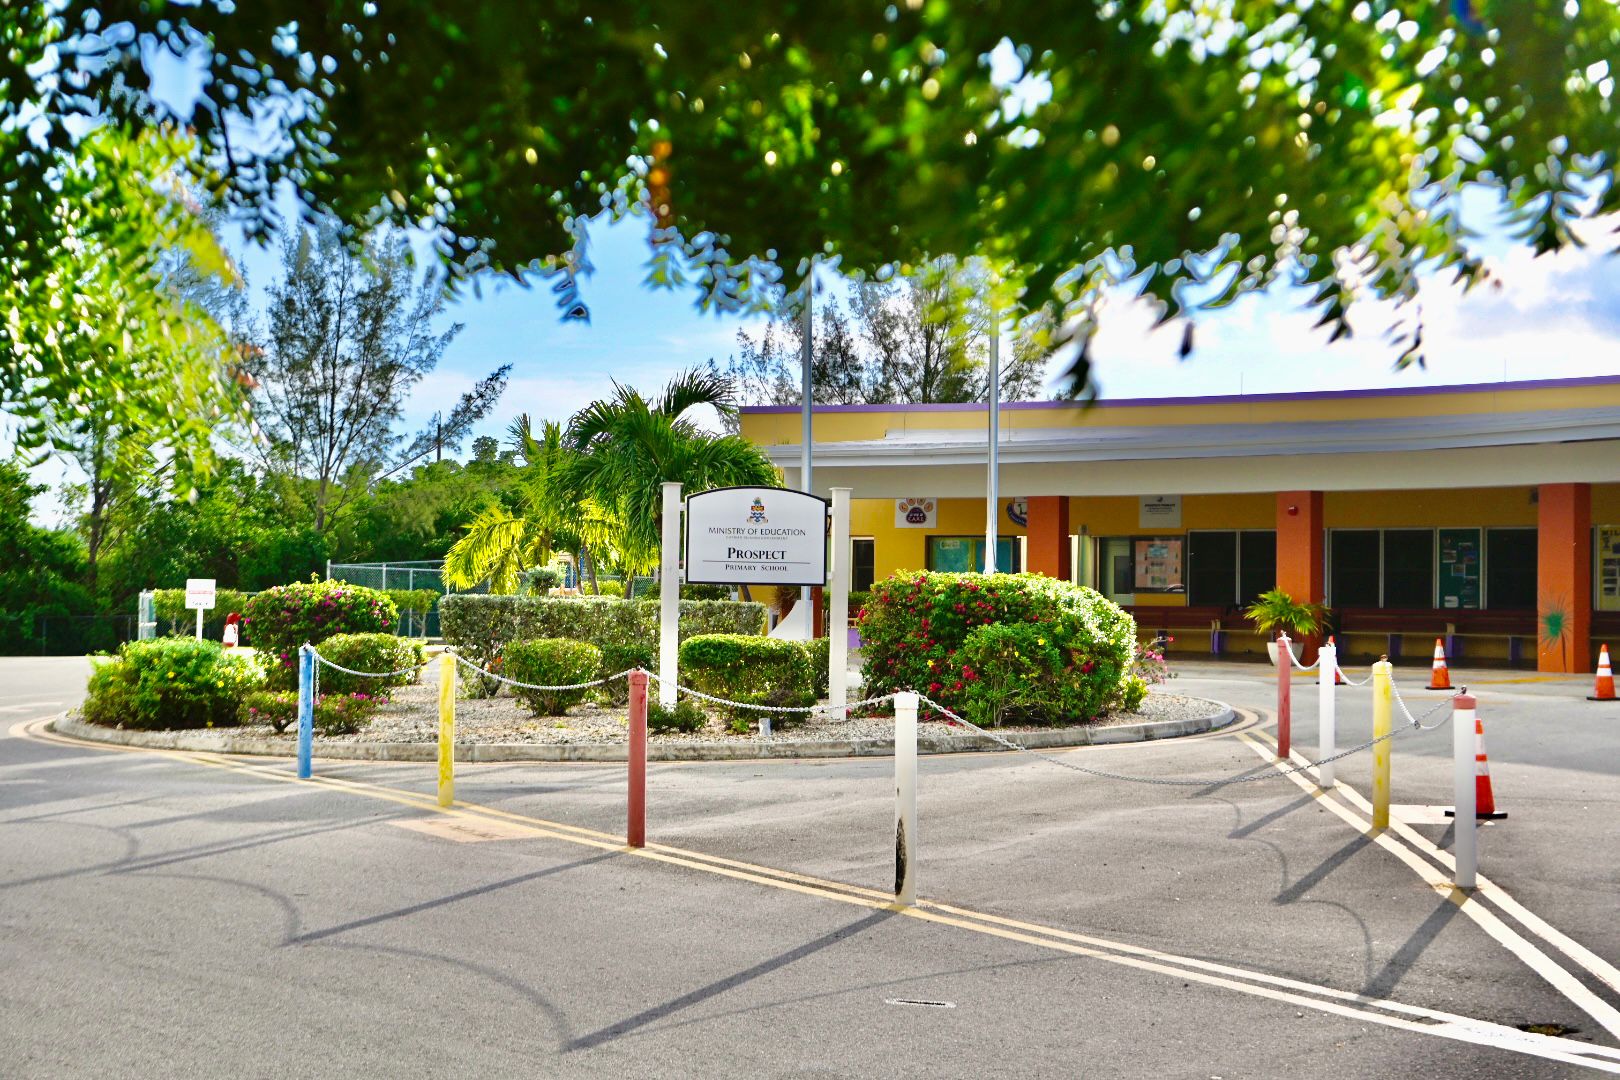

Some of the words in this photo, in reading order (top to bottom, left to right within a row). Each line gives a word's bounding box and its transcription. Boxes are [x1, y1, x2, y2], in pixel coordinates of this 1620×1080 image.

[708, 527, 746, 535] MINISTRY
[760, 528, 806, 536] EDUCATION
[727, 547, 787, 560] PROSPECT
[760, 564, 788, 572] SCHOOL
